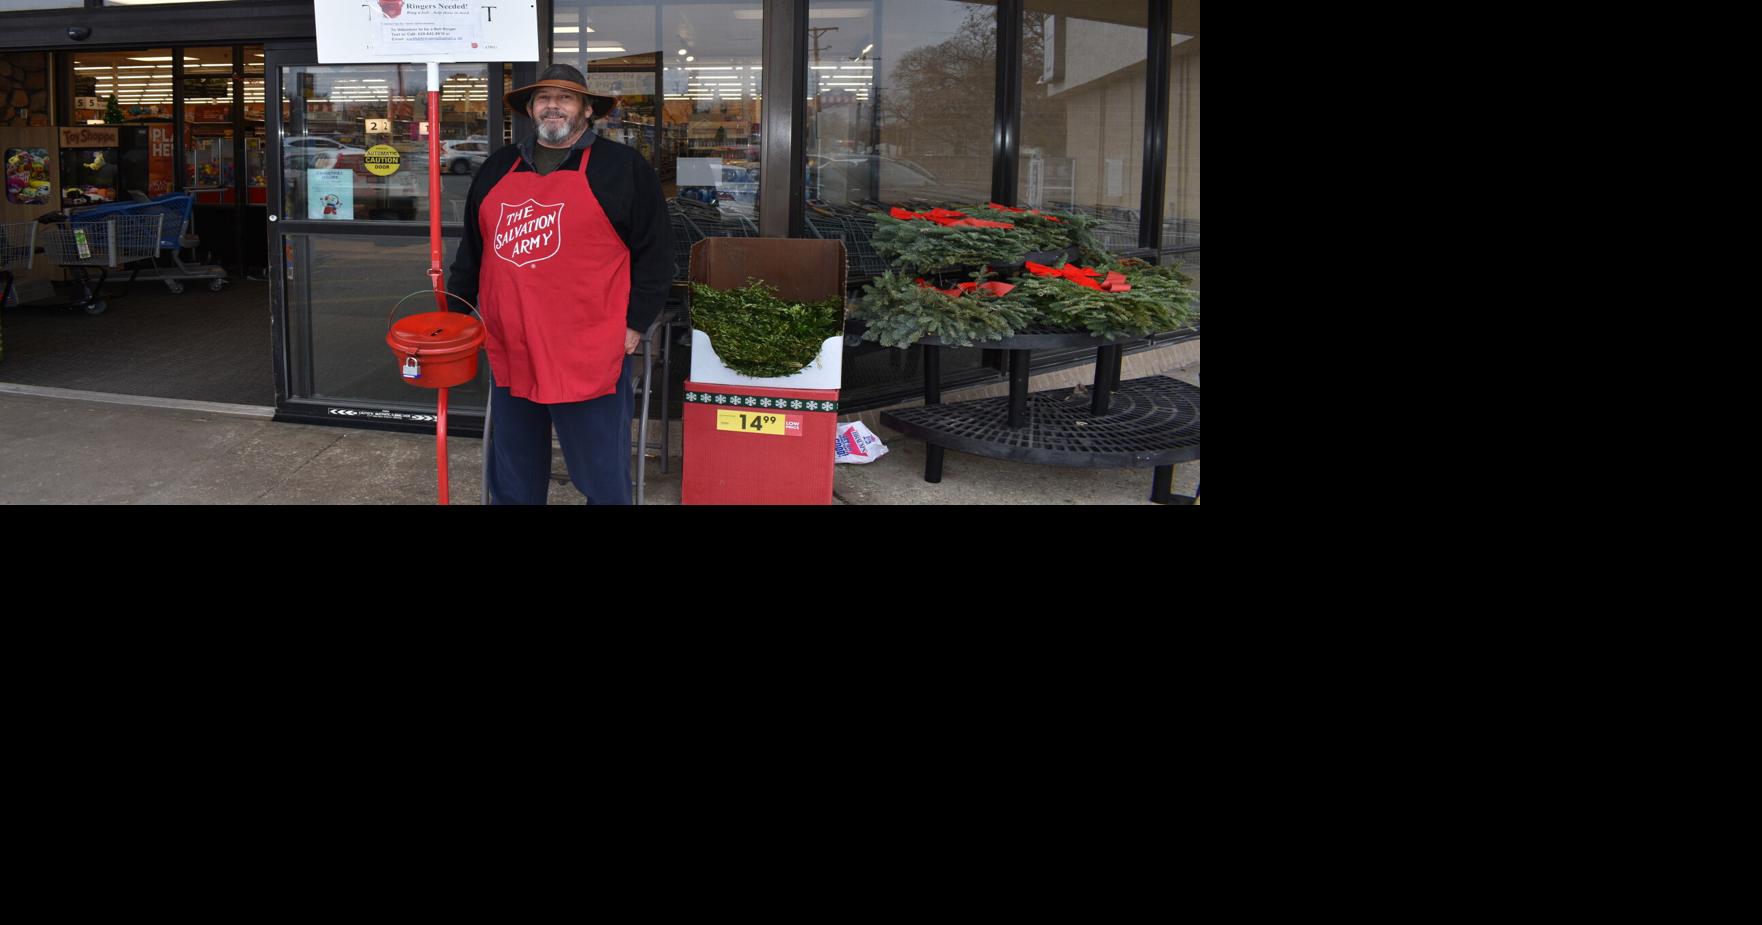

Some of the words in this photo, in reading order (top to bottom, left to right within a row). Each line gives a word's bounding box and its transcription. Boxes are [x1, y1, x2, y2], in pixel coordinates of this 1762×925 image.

[495, 210, 557, 250] SALVATION
[506, 205, 535, 227] THE
[511, 229, 553, 258] ARMY
